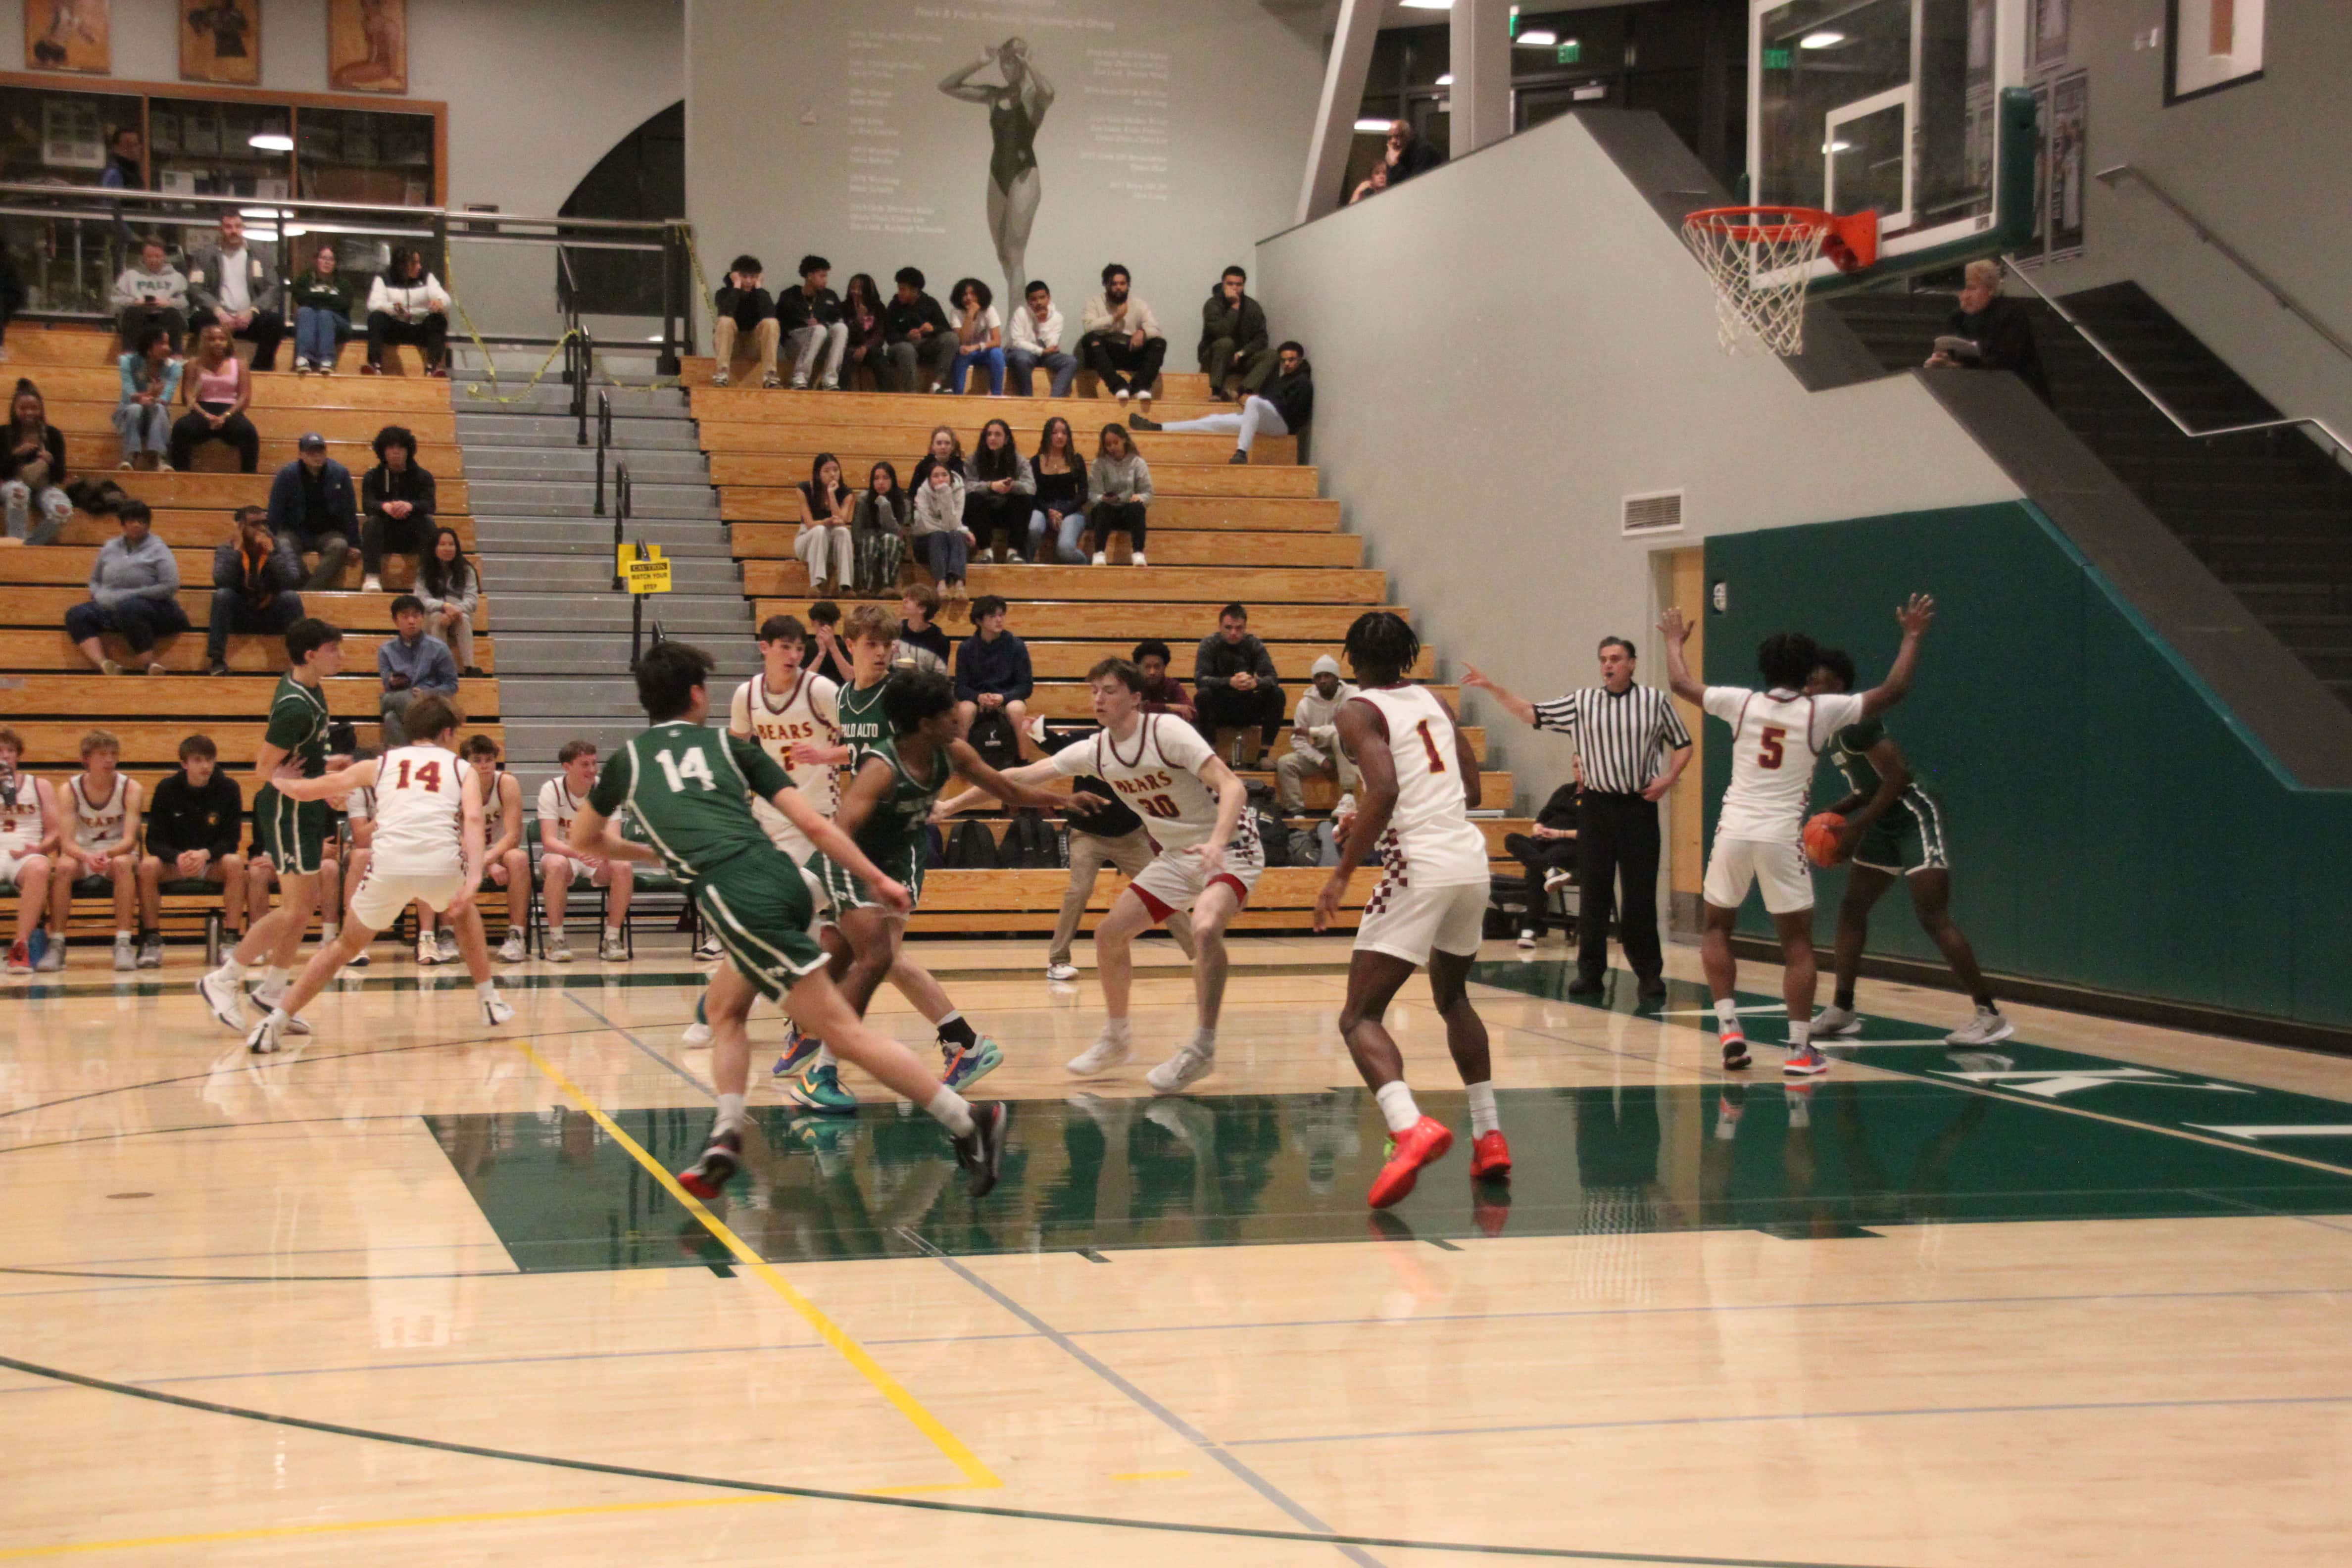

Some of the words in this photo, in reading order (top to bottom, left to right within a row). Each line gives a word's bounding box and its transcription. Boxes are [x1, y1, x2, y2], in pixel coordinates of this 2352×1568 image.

[137, 281, 172, 290] PALY
[757, 722, 813, 739] BEARS
[857, 723, 879, 737] ALTO
[1417, 718, 1446, 774] 1
[1758, 727, 1786, 770] 5
[396, 759, 441, 792] 14
[654, 747, 717, 792] 14
[1114, 771, 1173, 793] BEARS
